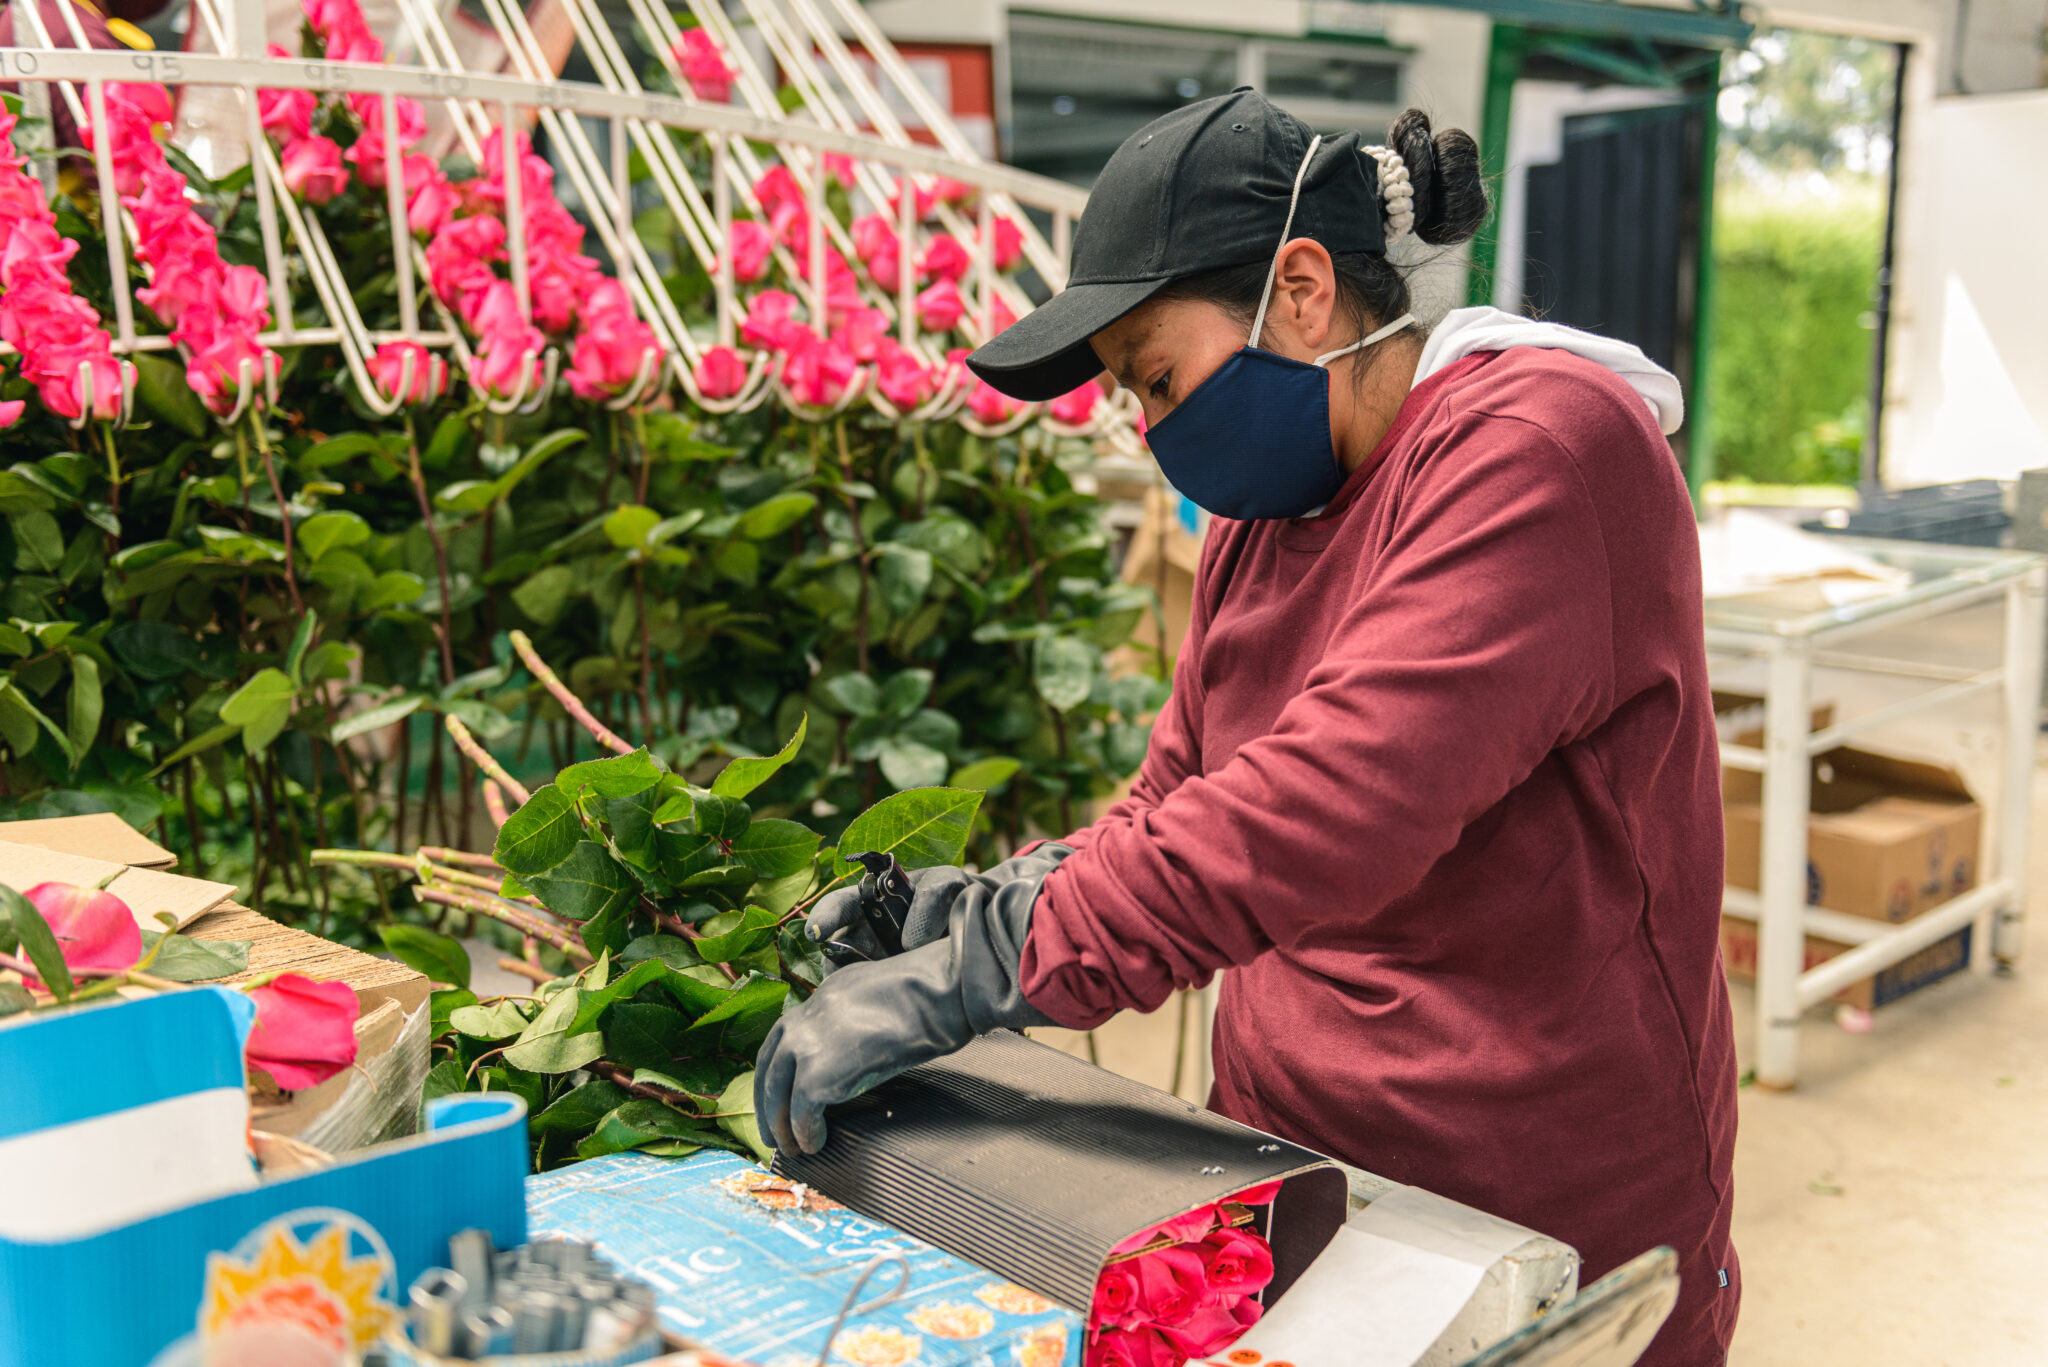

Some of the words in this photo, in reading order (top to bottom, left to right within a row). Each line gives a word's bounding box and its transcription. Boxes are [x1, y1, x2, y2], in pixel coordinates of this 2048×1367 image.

[0, 51, 38, 78] 0
[132, 55, 183, 81] 95
[304, 65, 353, 89] 95
